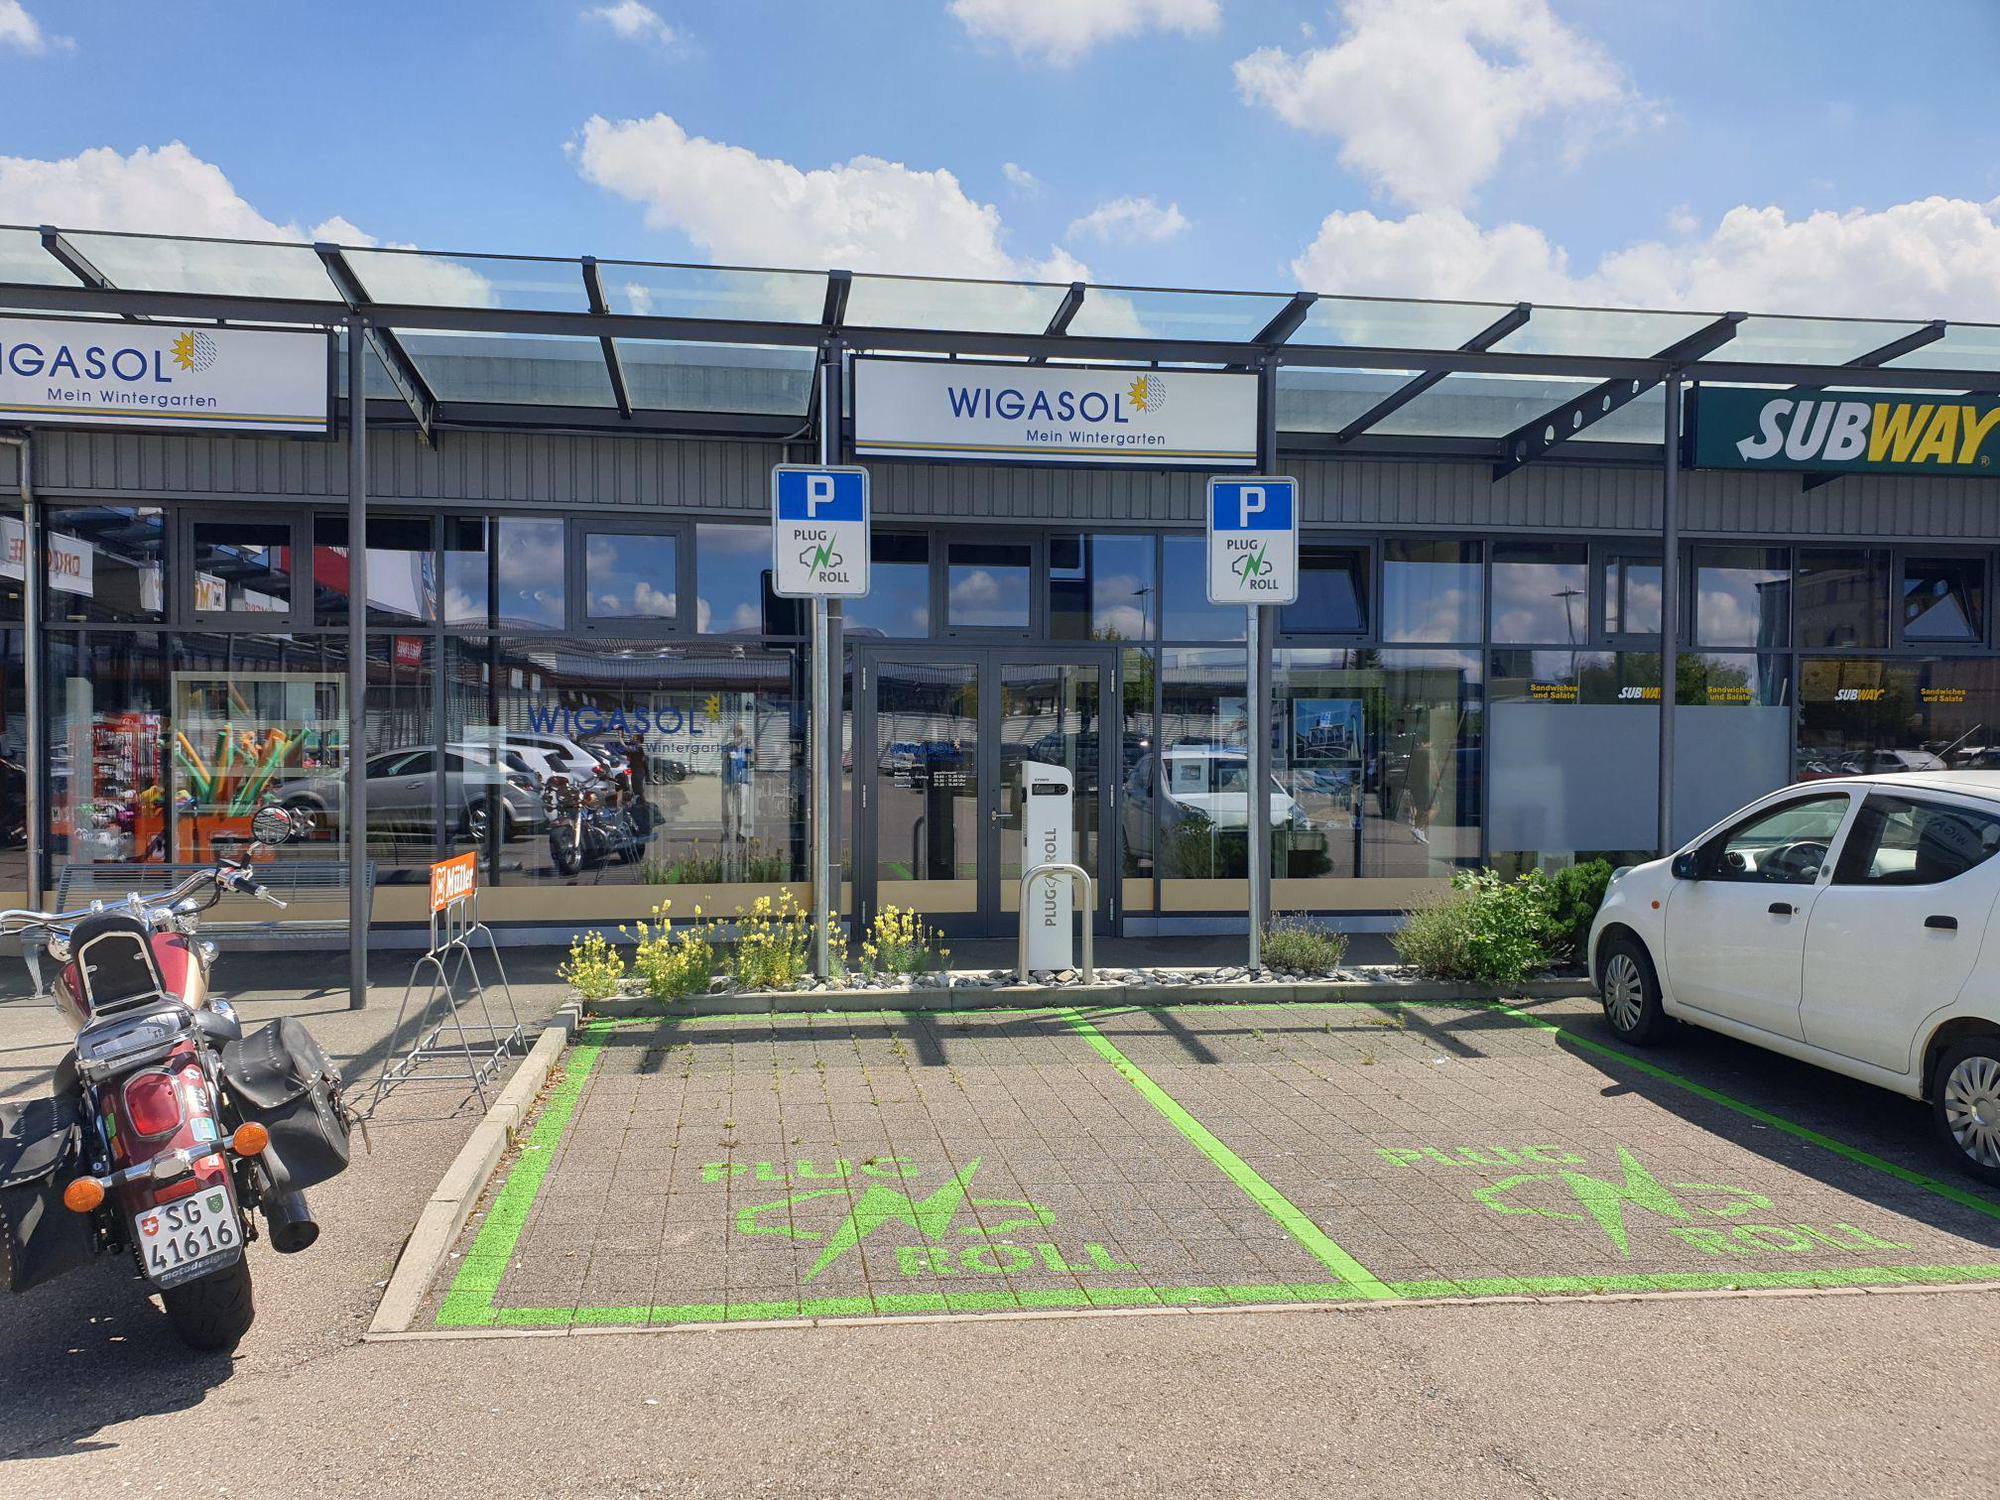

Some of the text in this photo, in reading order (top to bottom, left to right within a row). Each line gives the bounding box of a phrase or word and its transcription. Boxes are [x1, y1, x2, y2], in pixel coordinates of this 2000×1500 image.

[47, 387, 217, 408] Mein Wintergarten
[947, 387, 1128, 424] WIGASOL
[1026, 429, 1166, 446] Mein Wintergarten
[1736, 398, 2000, 465] SUBWAY
[807, 474, 835, 518] P
[1240, 486, 1266, 528] P
[794, 529, 827, 541] PLUG
[1226, 539, 1258, 550] PLUG
[819, 571, 850, 583] ROLL
[1250, 579, 1279, 590] ROLL
[1530, 683, 1578, 692] Sandwiches
[1617, 686, 1661, 699] SUBWA
[1707, 686, 1754, 694] Sandwiches
[1834, 688, 1885, 701] SUBWAY
[1920, 687, 1967, 695] Sandwiches
[527, 703, 704, 736] WIGASOL
[446, 862, 474, 898] Müller
[1045, 828, 1057, 926] PLUG ROLL
[1376, 1144, 1586, 1167] PLUG
[700, 1156, 919, 1184] PLUG
[165, 1200, 201, 1231] SG
[151, 1220, 233, 1268] 41616
[1668, 1223, 1916, 1257] ROLL
[896, 1242, 1141, 1276] ROLL
